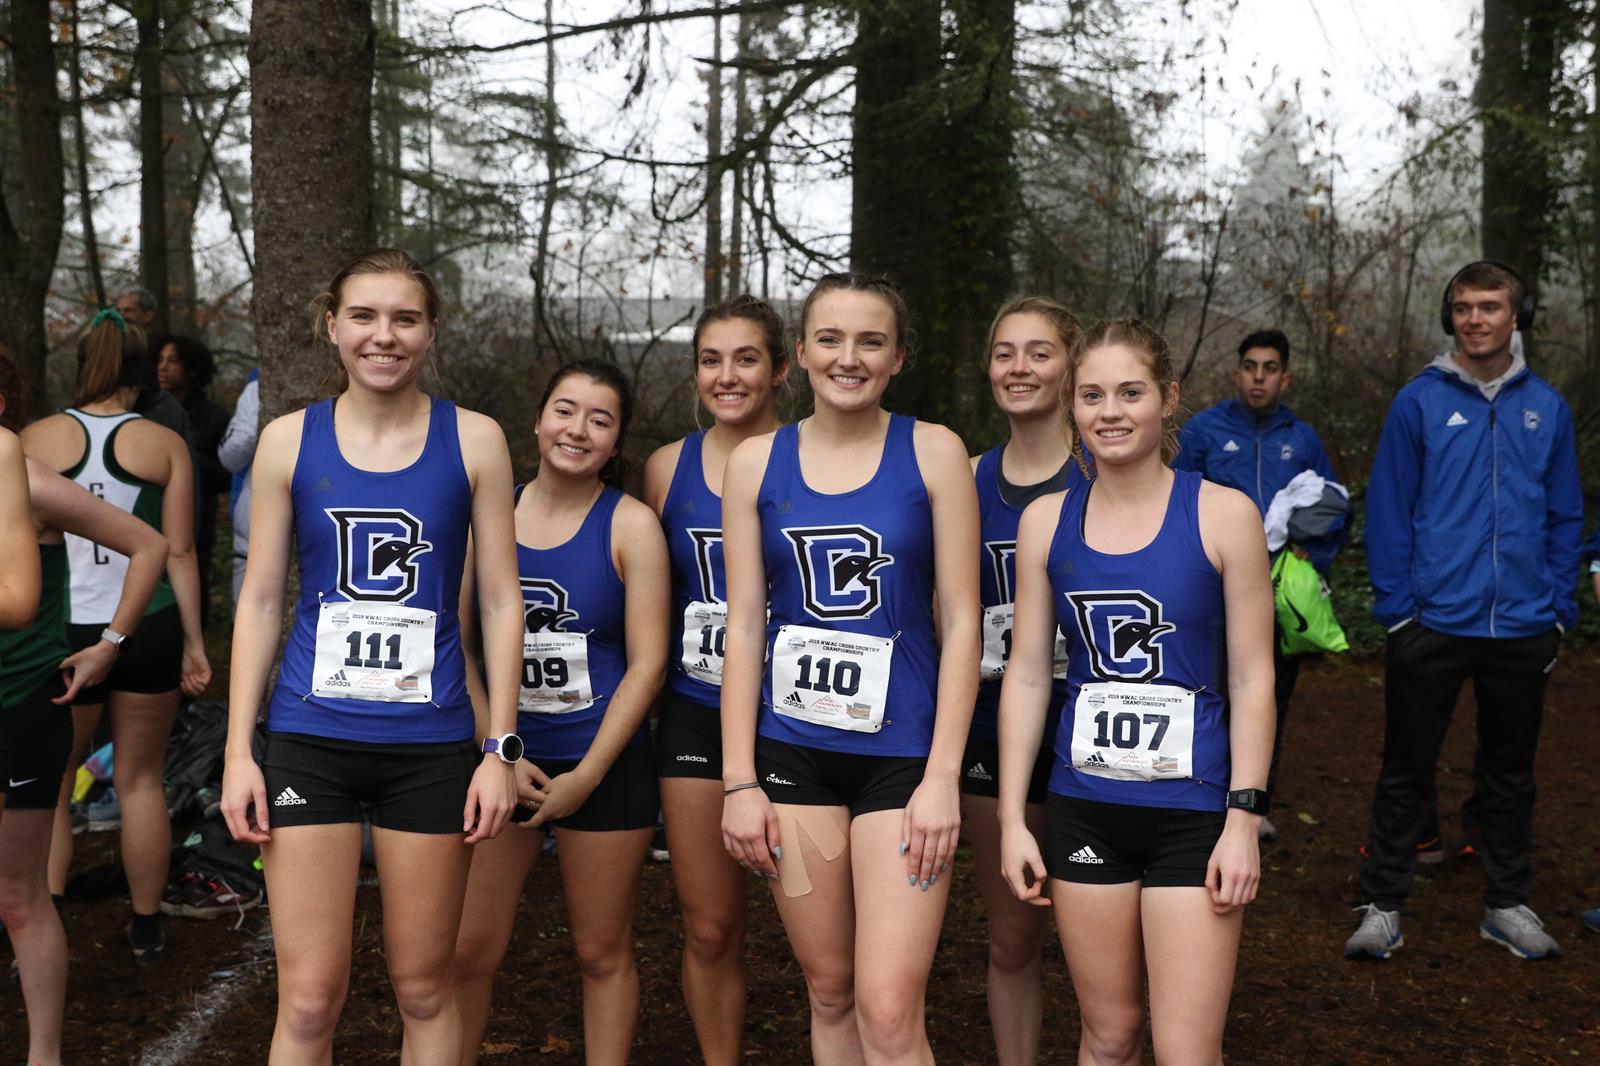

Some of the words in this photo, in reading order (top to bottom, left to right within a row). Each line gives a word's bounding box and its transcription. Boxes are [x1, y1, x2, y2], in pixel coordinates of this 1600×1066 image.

[401, 617, 425, 626] COUNTRY
[344, 631, 402, 670] 111
[822, 645, 864, 656] CHAMPIONSHIPS
[838, 642, 855, 650] CROSS
[855, 645, 880, 653] COUNTRY
[794, 654, 862, 697] 110
[325, 679, 351, 688] adidas
[783, 699, 806, 709] adidas
[1093, 710, 1170, 751] 107
[677, 754, 708, 763] adidas
[274, 798, 307, 806] adidas
[1068, 855, 1104, 865] adidas
